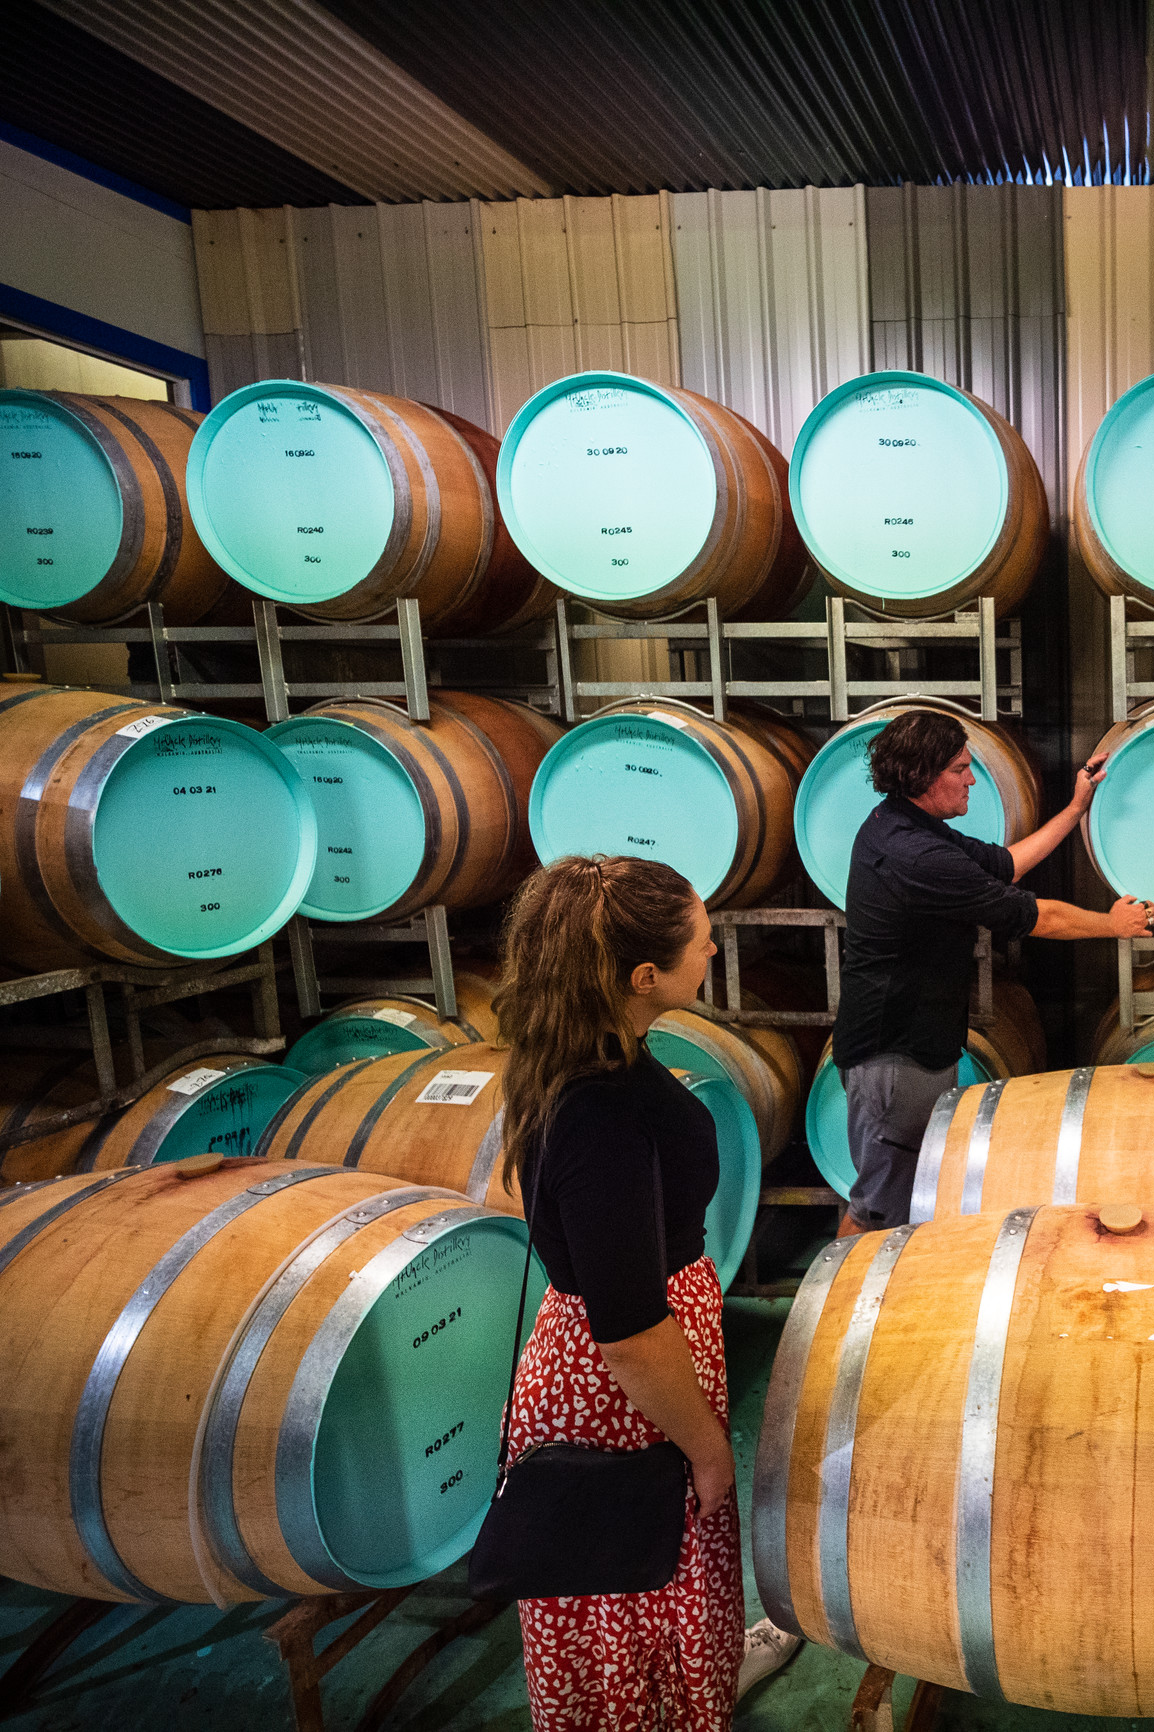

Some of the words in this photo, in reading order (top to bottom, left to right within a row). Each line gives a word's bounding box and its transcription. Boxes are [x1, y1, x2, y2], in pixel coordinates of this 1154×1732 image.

[883, 517, 914, 526] R0246
[26, 527, 55, 536] R0239
[296, 526, 325, 535] R0240
[600, 526, 633, 536] R0245
[303, 554, 322, 564] 300
[891, 549, 911, 559] 300
[36, 557, 55, 566] 300
[611, 558, 630, 567] 300
[626, 835, 656, 846] R0247
[187, 867, 223, 880] R0276
[333, 875, 351, 884] 300
[199, 901, 221, 913] 300
[424, 1420, 465, 1459] R0277
[439, 1469, 464, 1495] 300
